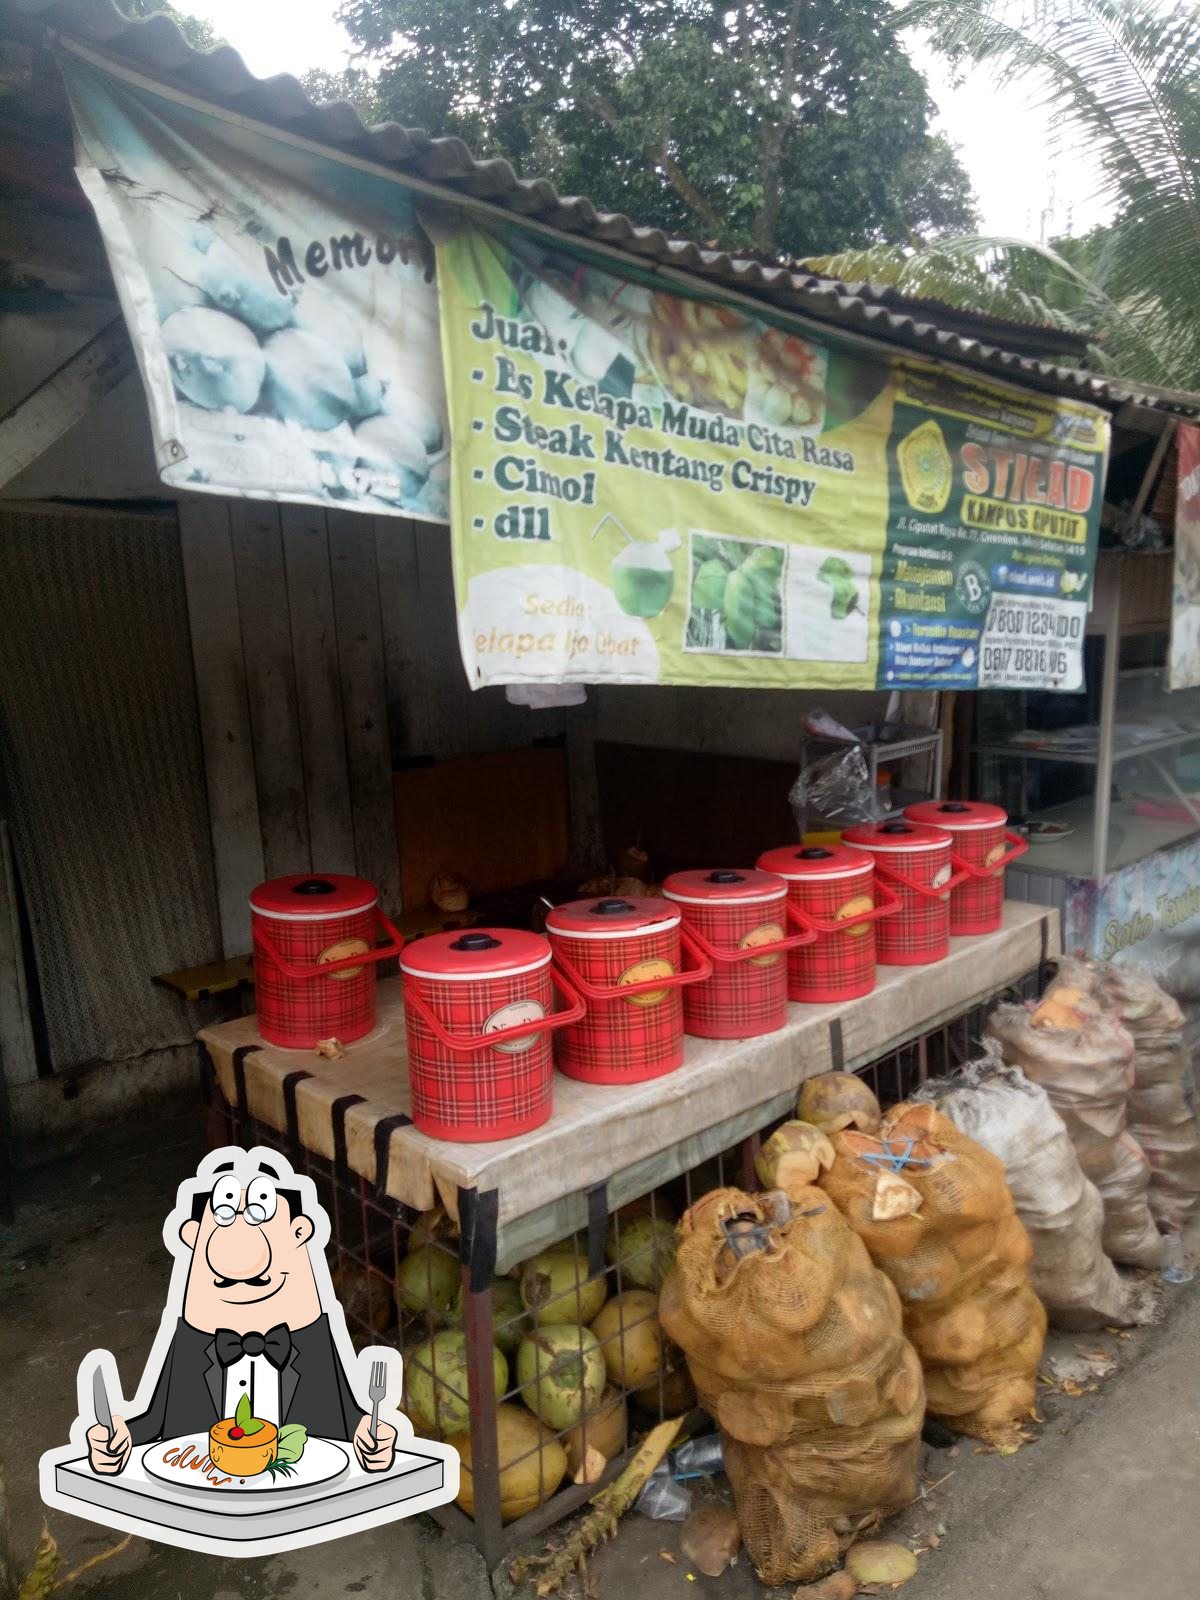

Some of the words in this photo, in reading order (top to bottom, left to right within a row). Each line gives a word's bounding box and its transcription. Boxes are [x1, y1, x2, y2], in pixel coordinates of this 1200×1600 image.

[495, 356, 533, 400] Es
[543, 369, 654, 431] Kelapa
[662, 402, 740, 447] Muda
[747, 424, 796, 459] Cita
[802, 436, 855, 472] Rasa
[494, 406, 596, 459] Steak
[604, 430, 725, 492] Kentang
[731, 460, 816, 506] Crispy
[494, 455, 596, 505] Cimol
[494, 505, 551, 541] dll
[964, 573, 982, 602] B
